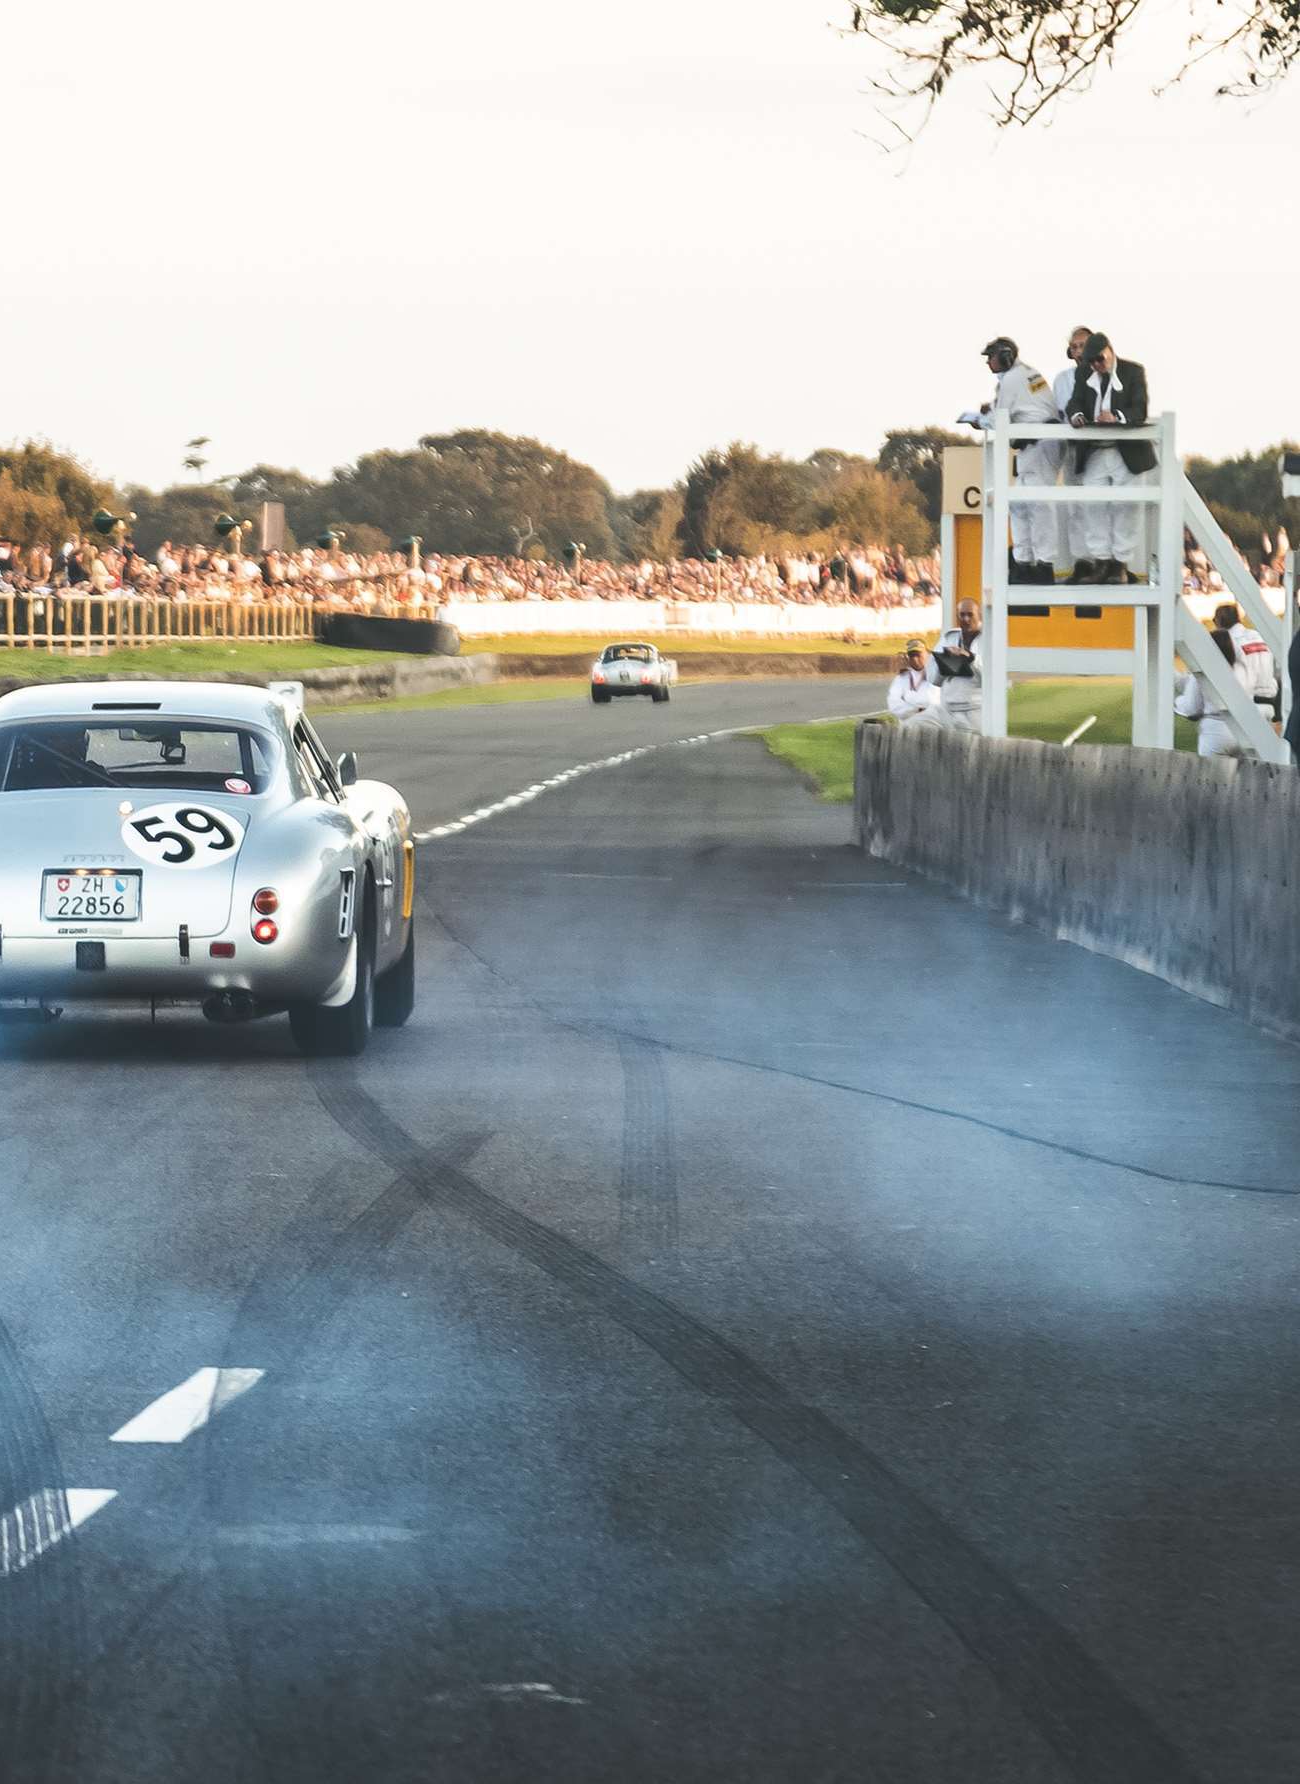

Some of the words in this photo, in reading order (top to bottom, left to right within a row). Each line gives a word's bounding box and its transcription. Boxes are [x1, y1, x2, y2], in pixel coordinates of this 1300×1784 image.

[130, 807, 236, 864] 59
[81, 877, 103, 893] ZH
[57, 896, 125, 916] 22856
